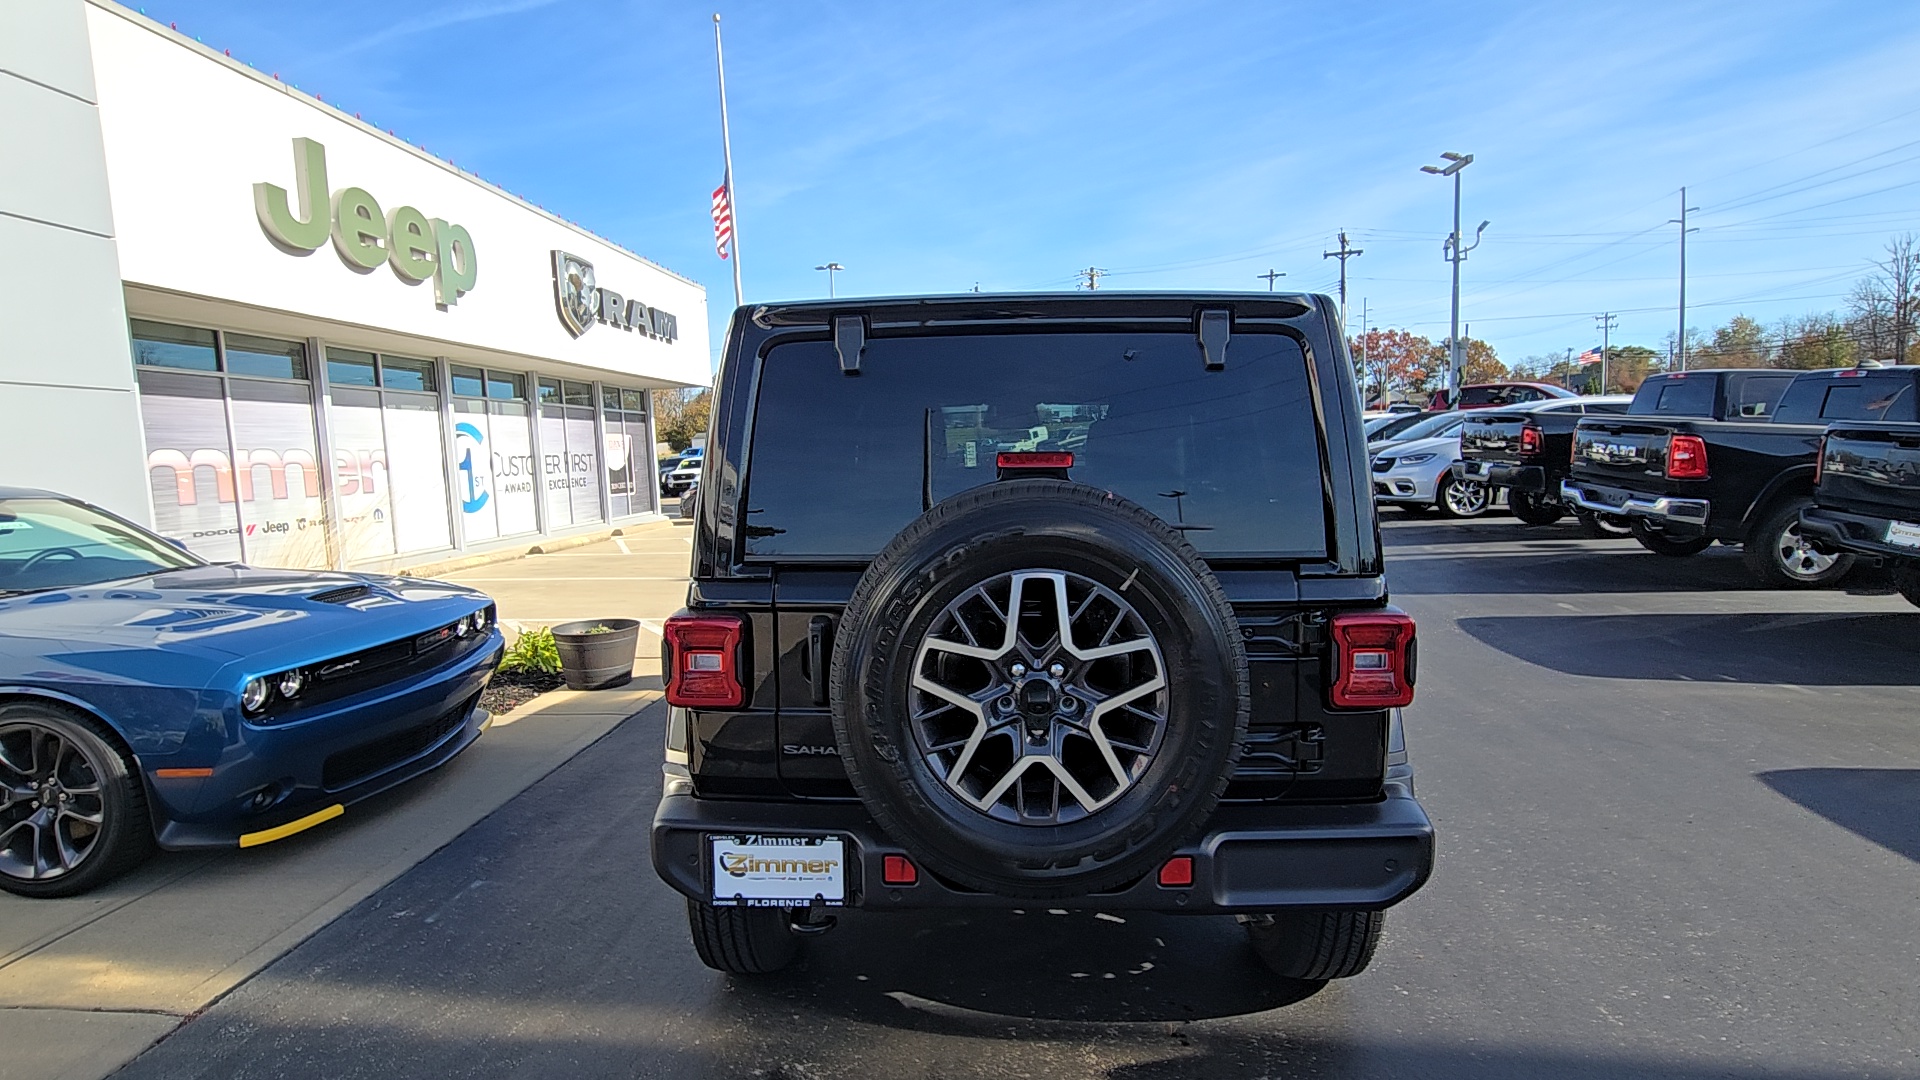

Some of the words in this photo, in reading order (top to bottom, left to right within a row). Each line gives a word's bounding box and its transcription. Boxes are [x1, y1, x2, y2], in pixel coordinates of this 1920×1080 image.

[253, 137, 477, 312] Jeep
[600, 287, 679, 345] RAM
[1590, 442, 1637, 458] RAM
[1862, 456, 1920, 476] RA
[504, 481, 532, 494] AWARD
[192, 528, 240, 538] DODG
[262, 519, 290, 535] Jeep
[745, 834, 809, 846] Zimmer
[727, 853, 839, 874] Zimmer
[747, 899, 811, 907] FLORENCE
